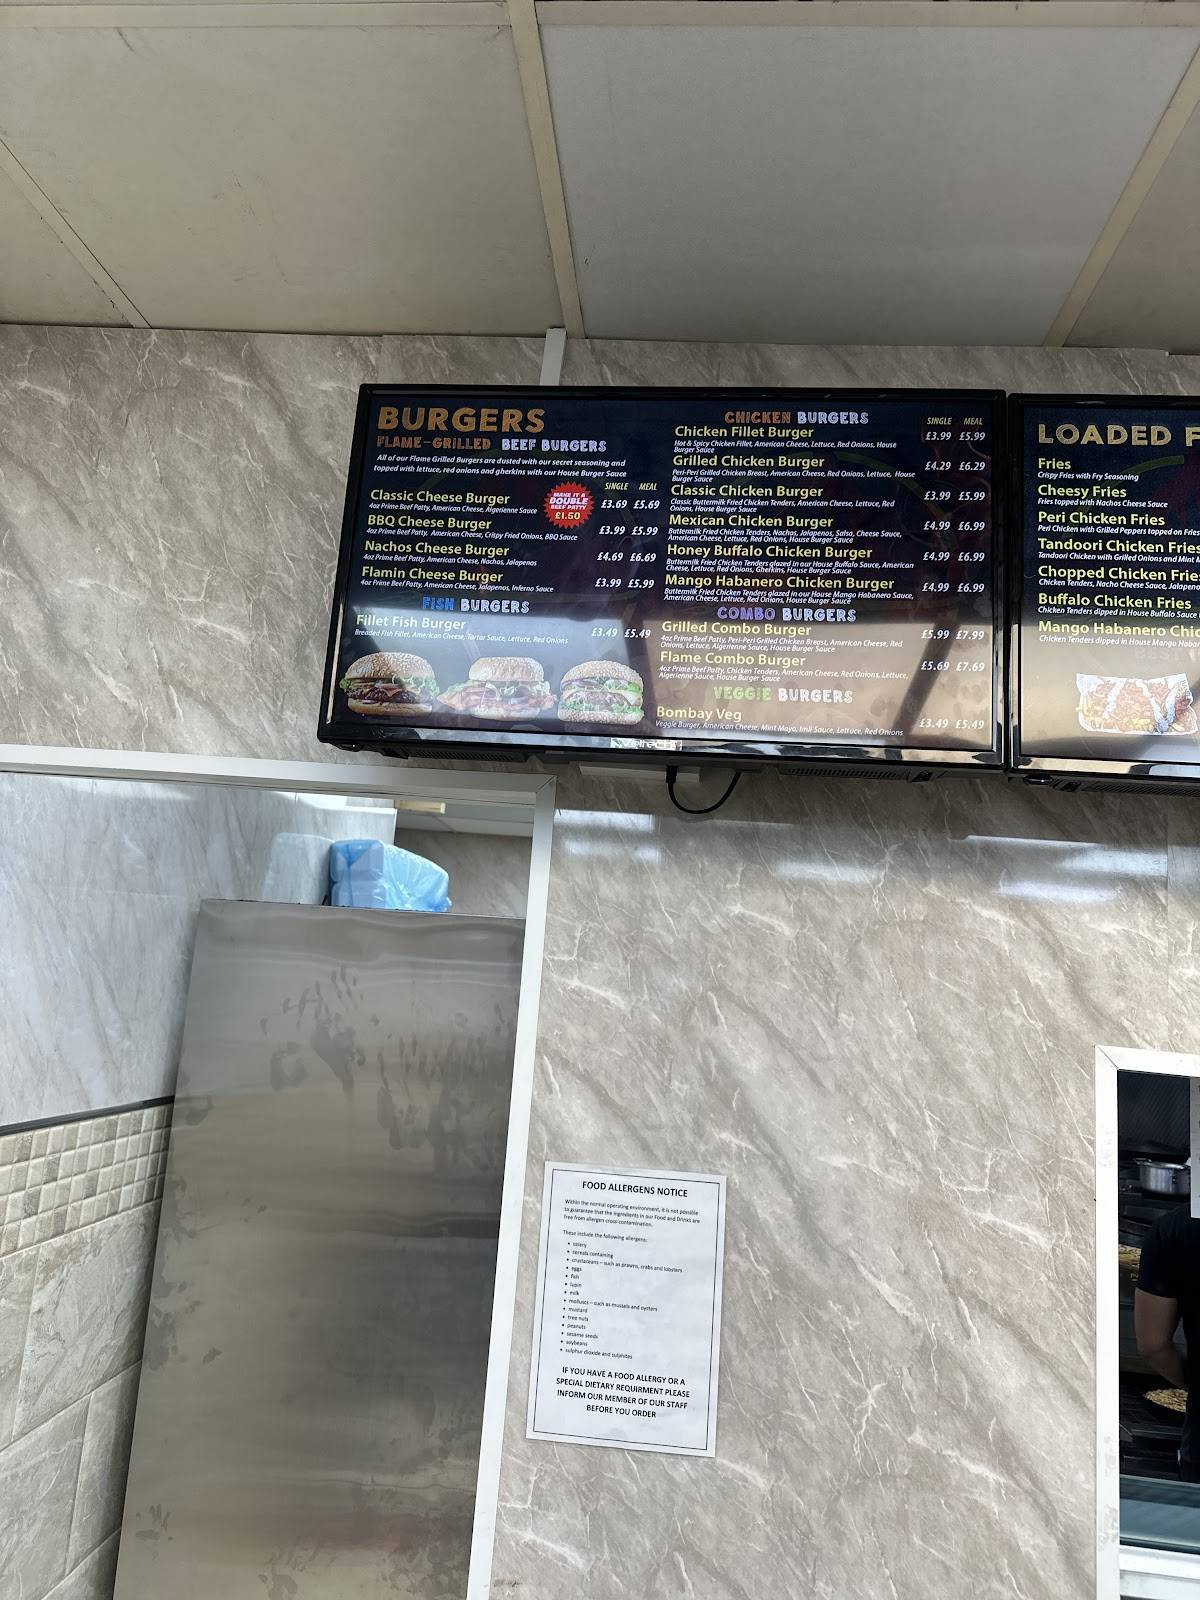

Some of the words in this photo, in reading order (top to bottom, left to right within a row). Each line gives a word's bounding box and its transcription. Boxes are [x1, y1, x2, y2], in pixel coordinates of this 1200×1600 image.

[377, 406, 545, 433] BURGERS
[724, 411, 790, 423] CHICKEN
[797, 411, 868, 424] BURGERS
[675, 425, 727, 436] Chicken
[731, 426, 764, 437] Fillet
[768, 426, 813, 440] Burger
[925, 431, 951, 440] £3.99
[958, 431, 985, 440] £5.99
[1038, 423, 1171, 445] LOADED
[376, 435, 491, 449] FLAME-GRILLED
[501, 438, 536, 450] BEEF
[541, 439, 606, 452] BURGERS
[672, 454, 717, 466] Grilled
[721, 455, 774, 466] Chicken
[778, 455, 824, 469] Burger
[924, 460, 951, 470] £4.29
[958, 461, 985, 470] £6.29
[1038, 457, 1071, 469] Fries
[1037, 471, 1058, 480] Crispy
[1091, 472, 1103, 480] Fry
[1104, 472, 1139, 482] Seasoning
[604, 482, 628, 490] SINGLE
[638, 482, 658, 491] MEAL
[671, 484, 715, 495] Classic
[719, 484, 772, 496] Chicken
[776, 485, 823, 499] Burger
[1037, 484, 1089, 499] Cheesy
[1092, 485, 1126, 497] Fries
[370, 489, 413, 501] Classic
[416, 490, 462, 502] Cheese
[466, 492, 510, 506] Burger
[550, 497, 588, 505] DOUBLE
[923, 490, 950, 500] £3.99
[958, 491, 985, 500] £5.99
[600, 499, 627, 508] £3.69
[633, 499, 660, 509] £5.69
[367, 514, 395, 527] BBQ
[398, 515, 444, 527] Cheese
[447, 517, 491, 531] Burger
[669, 514, 724, 525] Mexican
[728, 514, 782, 526] Chicken
[786, 515, 833, 529] Burger
[923, 520, 950, 530] £4.99
[958, 521, 985, 530] £6.99
[1038, 511, 1065, 522] Peri
[1069, 511, 1126, 524] Chicken
[1130, 513, 1165, 525] Fries
[598, 525, 625, 535] £3.99
[631, 526, 658, 535] £5.99
[364, 540, 411, 552] Nachos
[415, 542, 461, 554] Cheese
[465, 543, 509, 558] Burger
[667, 543, 710, 558] Honey
[714, 544, 762, 556] Buffalo
[765, 545, 820, 557] Chicken
[825, 546, 872, 560] Burger
[1037, 537, 1102, 550] Tandoori
[1105, 539, 1163, 552] Chicken
[596, 551, 623, 561] £4.69
[629, 552, 656, 562] £6.69
[922, 551, 950, 561] £4.99
[957, 551, 984, 561] £6.99
[362, 566, 406, 578] Flamin
[408, 567, 455, 580] Cheese
[459, 569, 503, 584] Burger
[1038, 565, 1104, 581] Chopped
[1108, 567, 1166, 580] Chicken
[1171, 569, 1200, 582] Frie
[594, 577, 621, 587] £3.99
[627, 578, 654, 588] £5.99
[665, 574, 712, 589] Mango
[716, 575, 782, 587] Habanero
[786, 576, 841, 588] Chicken
[846, 577, 894, 591] Burger
[921, 582, 949, 592] £4.99
[957, 582, 984, 592] £6.99
[422, 596, 455, 610] FISH
[459, 598, 529, 613] BURGERS
[1038, 592, 1090, 606] Buffalo
[1093, 594, 1152, 608] Chicken
[1157, 596, 1191, 609] Fries
[716, 606, 775, 621] COMBO
[782, 607, 856, 622] BURGERS
[356, 614, 388, 627] Fillet
[392, 615, 417, 627] Fish
[421, 617, 466, 630] Burger
[661, 620, 707, 633] Grilled
[711, 622, 760, 634] Combo
[764, 623, 811, 638] Burger
[1038, 620, 1090, 635] Mango
[1094, 623, 1166, 637] Habanero
[592, 627, 618, 637] £3.49
[624, 628, 651, 638] £5.49
[922, 629, 949, 640] £5.99
[956, 630, 984, 640] £7.99
[660, 652, 701, 664] Flame
[705, 653, 754, 666] Combo
[758, 653, 806, 668] Burger
[922, 661, 950, 672] £5.69
[955, 661, 985, 671] £7.69
[713, 686, 771, 700] VEGGIE
[778, 687, 852, 704] BURGERS
[656, 705, 713, 722] Bombay
[715, 707, 741, 722] Veg
[919, 718, 948, 728] £3.49
[956, 719, 984, 730] £5.49
[582, 1180, 606, 1190] FOOD
[608, 1183, 654, 1194] ALLERGENS
[657, 1187, 687, 1197] NOTICE
[586, 1369, 605, 1377] HAVE
[614, 1372, 634, 1380] FOOD
[635, 1374, 666, 1383] ALLERGY
[556, 1377, 583, 1386] SPECIAL
[585, 1380, 614, 1389] DIETARY
[616, 1383, 663, 1394] REQUIRMENT
[664, 1388, 689, 1397] PLEASE
[557, 1389, 585, 1398] INFORM
[604, 1394, 636, 1404] MEMBER
[666, 1400, 687, 1408] STAFF
[586, 1404, 612, 1413] BEFORE
[614, 1407, 630, 1415] YOU
[631, 1409, 656, 1417] ORDER
